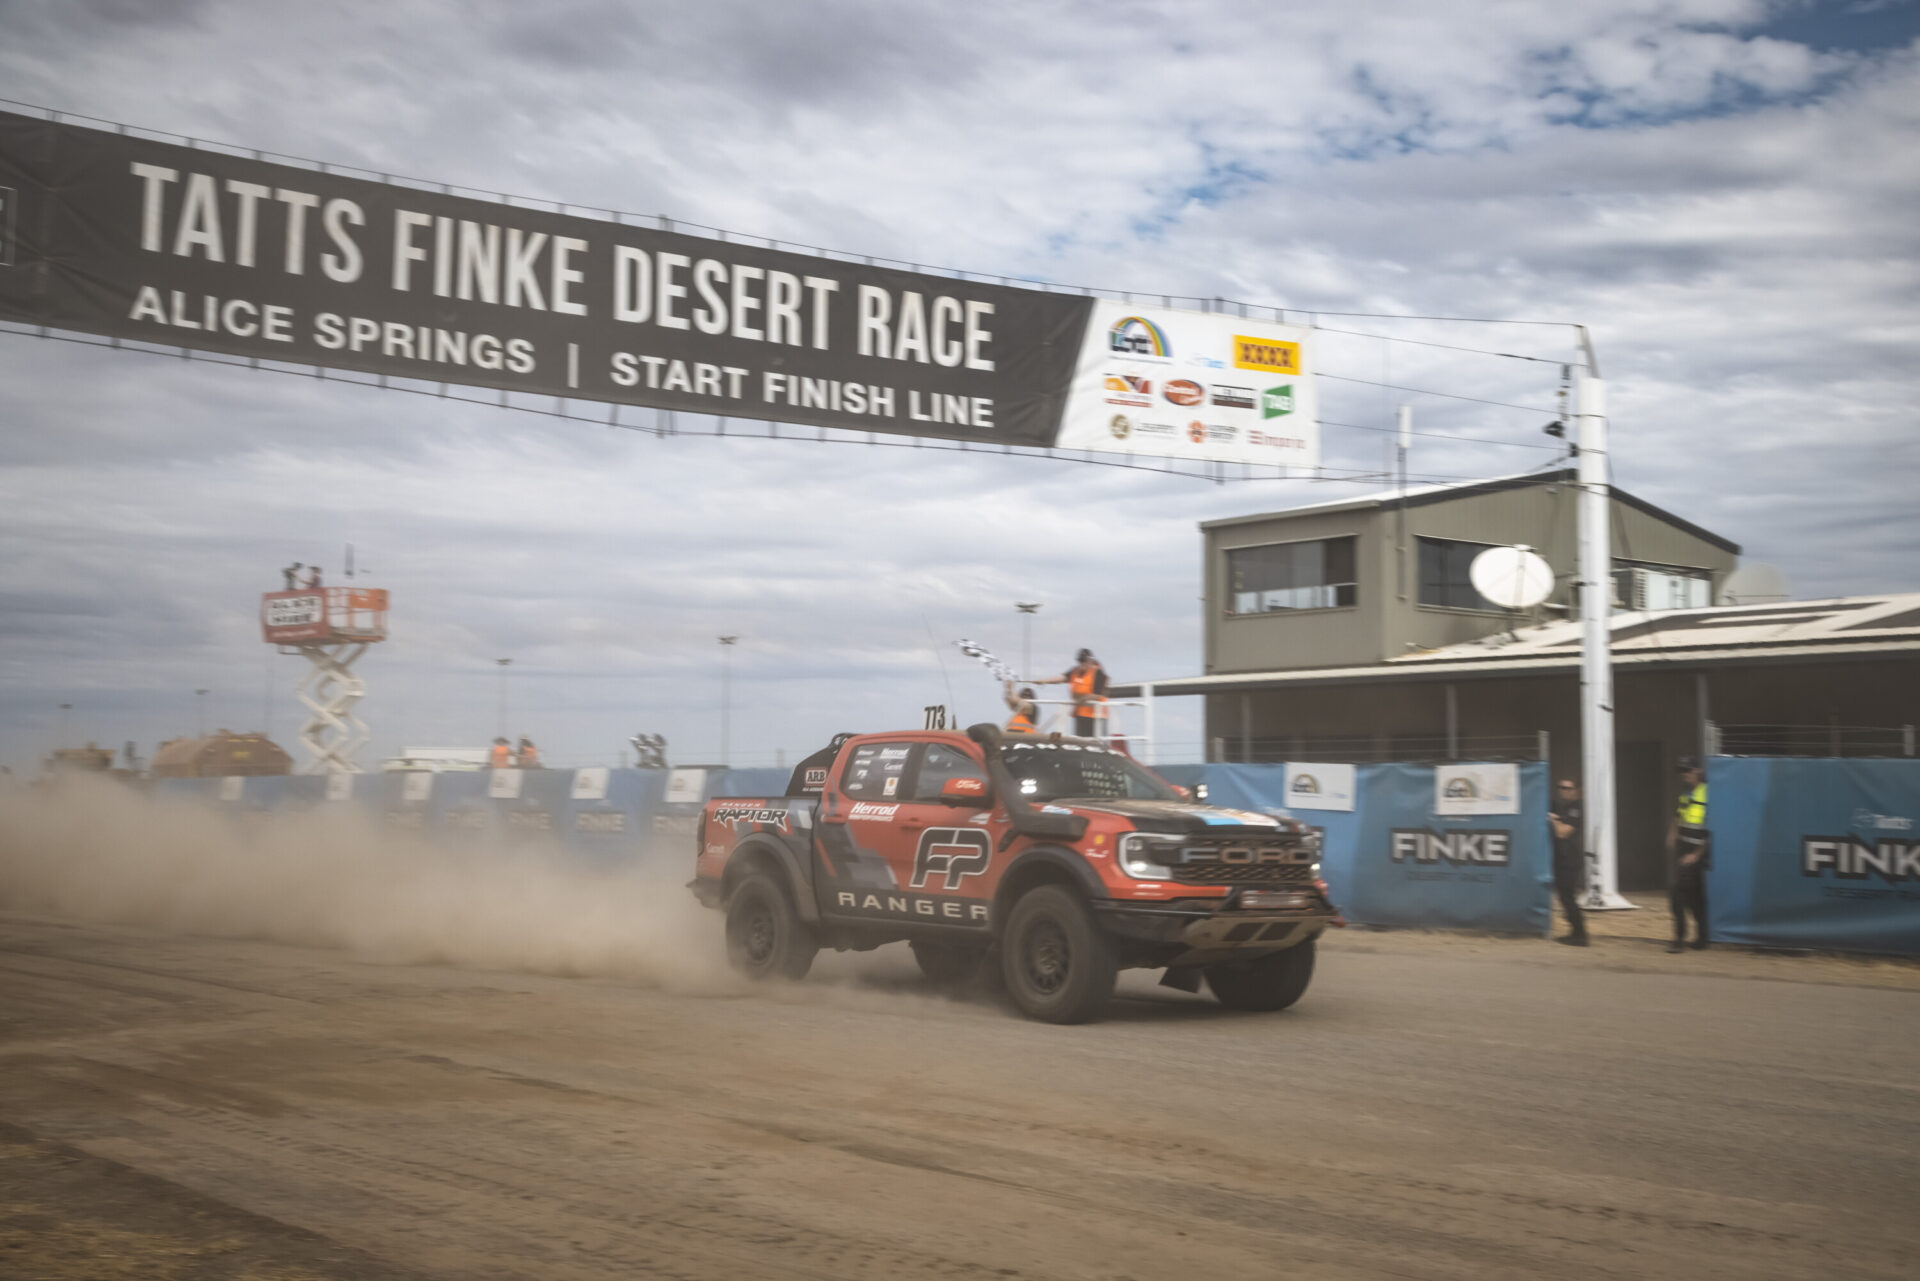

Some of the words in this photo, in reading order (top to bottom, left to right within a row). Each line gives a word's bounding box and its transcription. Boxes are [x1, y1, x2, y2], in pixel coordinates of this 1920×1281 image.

[131, 161, 366, 283] TATTS
[392, 207, 590, 318] FINKE
[613, 243, 841, 351] DESERT
[857, 283, 996, 373] RACE
[129, 285, 295, 343] ALICE
[313, 311, 536, 375] SPRINGS
[609, 350, 750, 400] START
[763, 371, 896, 419] FINISH
[908, 389, 996, 429] LINE
[1239, 342, 1294, 368] XXXX
[924, 704, 946, 730] 773
[807, 771, 826, 782] ARB
[712, 807, 789, 832] RAPTOR
[850, 801, 901, 816] Herrod
[1181, 847, 1311, 865] FORD
[1391, 829, 1510, 864] FINKE
[1803, 839, 1920, 877] FINK
[838, 891, 990, 920] RANGER
